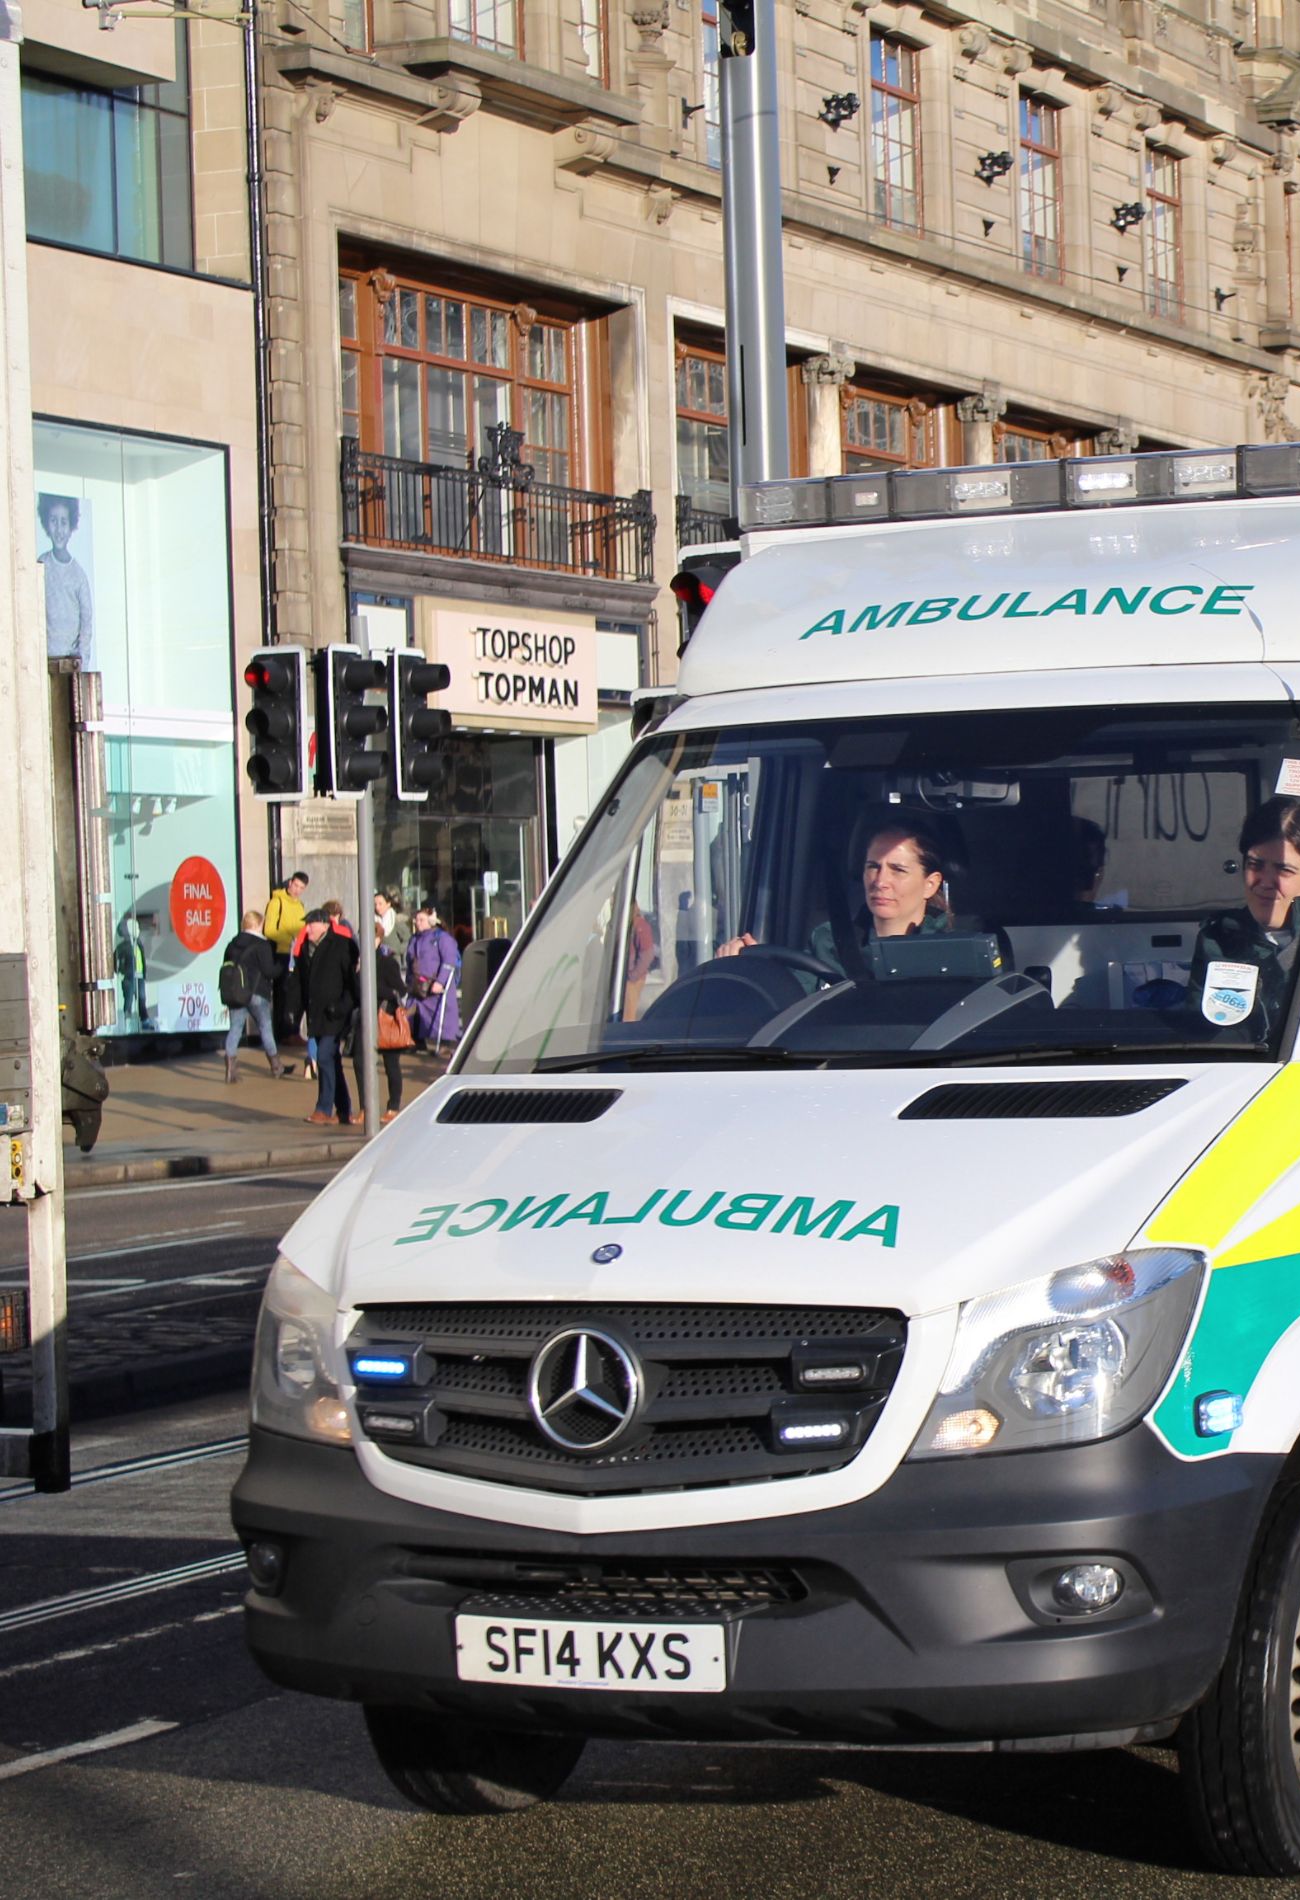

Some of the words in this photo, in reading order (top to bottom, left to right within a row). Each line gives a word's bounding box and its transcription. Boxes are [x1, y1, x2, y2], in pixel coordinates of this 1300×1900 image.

[798, 584, 1256, 640] AMBULANCE
[475, 627, 576, 666] TOPSHOP
[477, 671, 579, 707] TOPMAN
[183, 883, 212, 900] FINAL
[185, 910, 212, 927] SALE
[181, 983, 193, 995] UP
[193, 982, 204, 994] TO
[177, 996, 210, 1019] 70%
[187, 1018, 201, 1030] OFF
[485, 1625, 581, 1677] SF14
[596, 1631, 692, 1681] KXS
